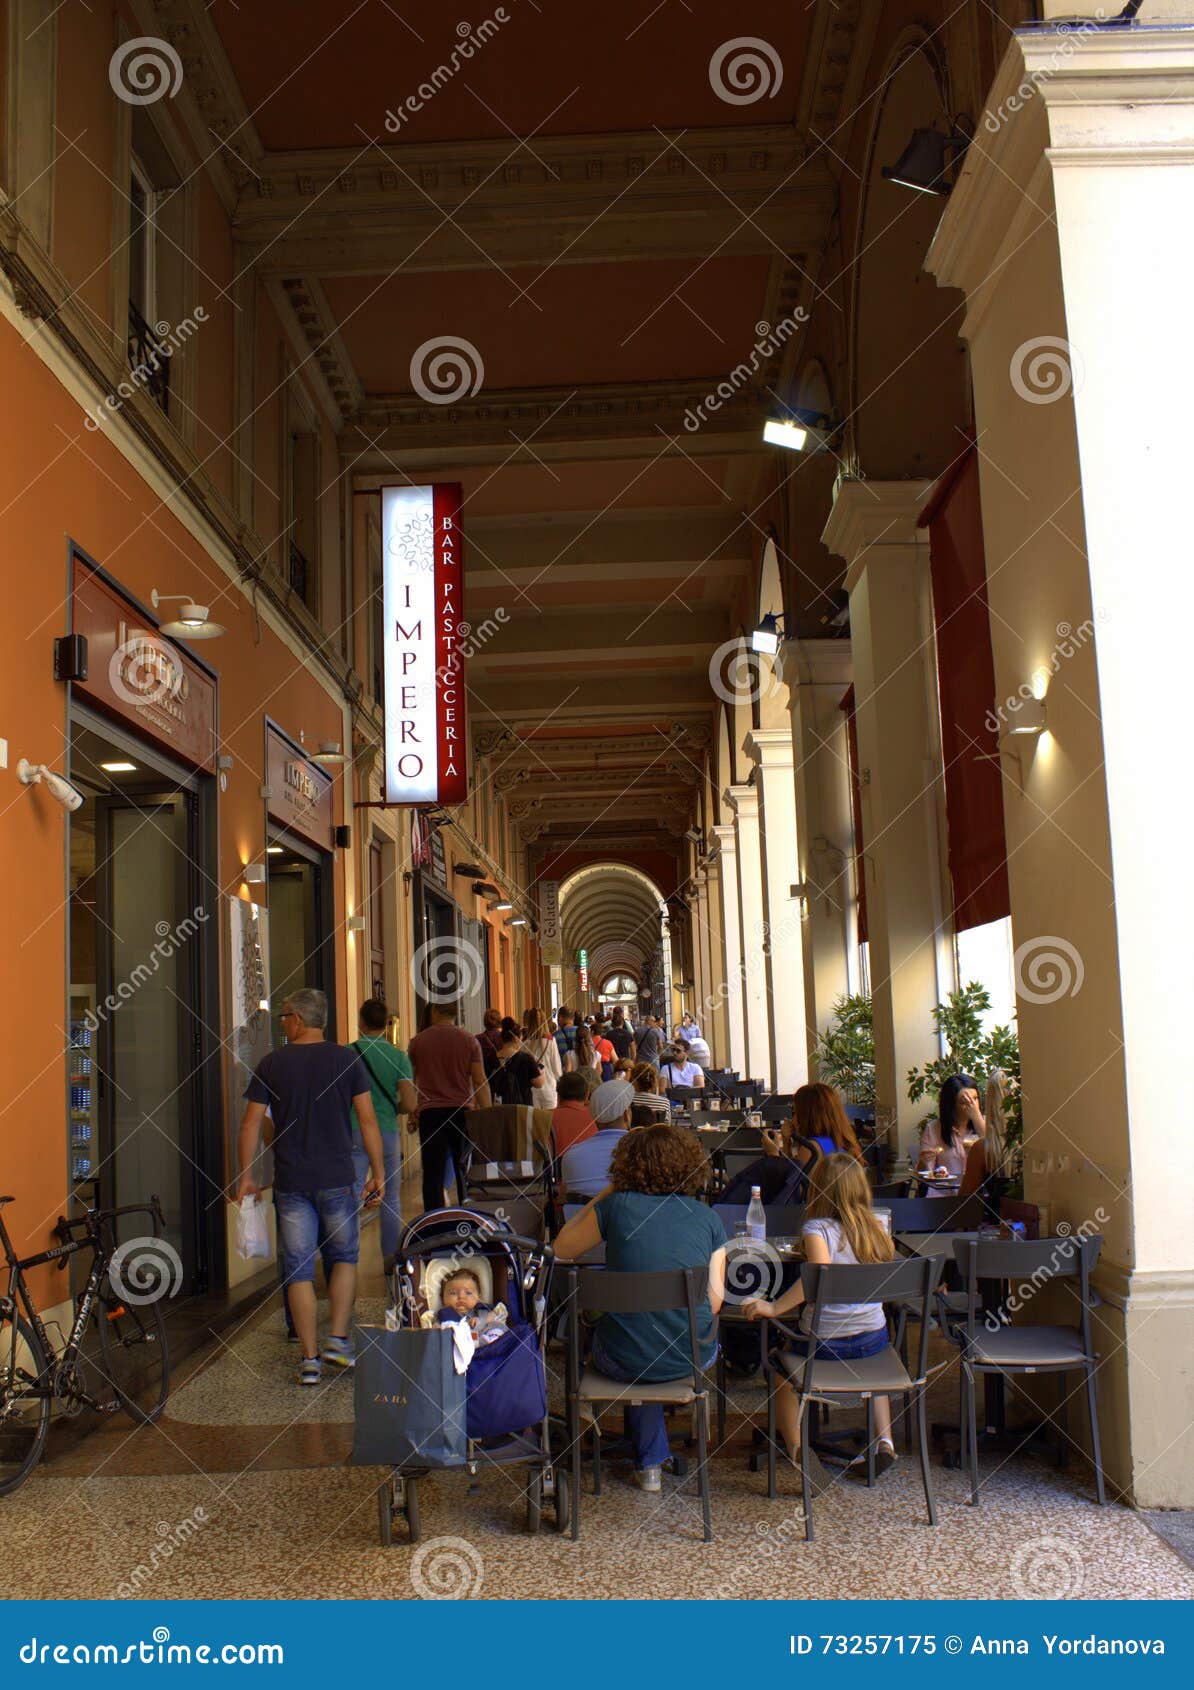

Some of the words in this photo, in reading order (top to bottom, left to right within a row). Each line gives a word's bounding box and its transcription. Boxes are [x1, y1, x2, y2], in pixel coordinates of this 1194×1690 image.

[442, 517, 455, 565] BAR
[395, 585, 424, 778] IMPERO
[442, 583, 458, 777] PASTICCERIA
